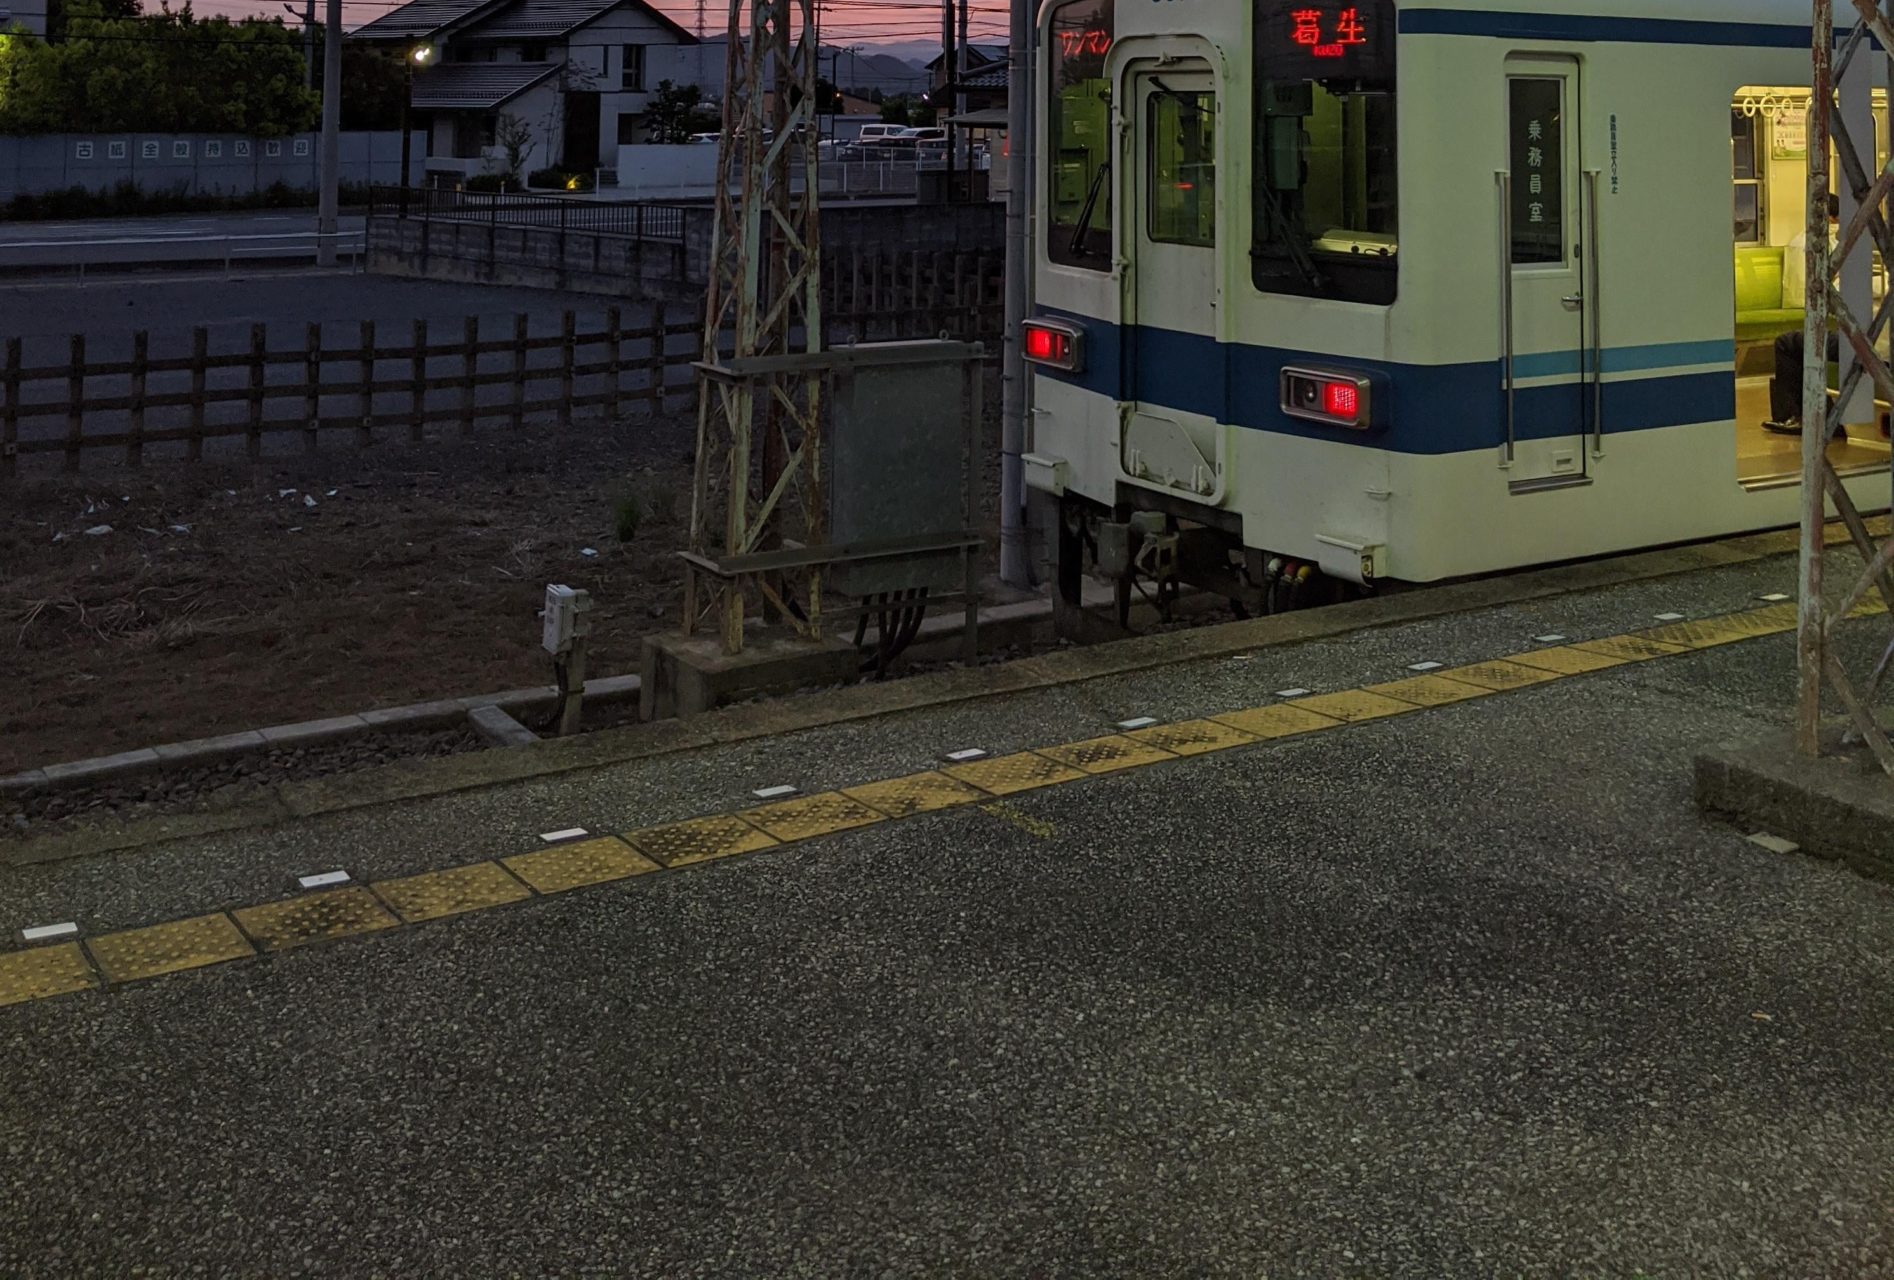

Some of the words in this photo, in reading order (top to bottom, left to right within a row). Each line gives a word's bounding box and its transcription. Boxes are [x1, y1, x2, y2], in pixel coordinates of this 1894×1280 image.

[1058, 29, 1111, 56] ワンマン
[1291, 7, 1366, 45] 葛生
[1527, 119, 1543, 222] 乗務員室
